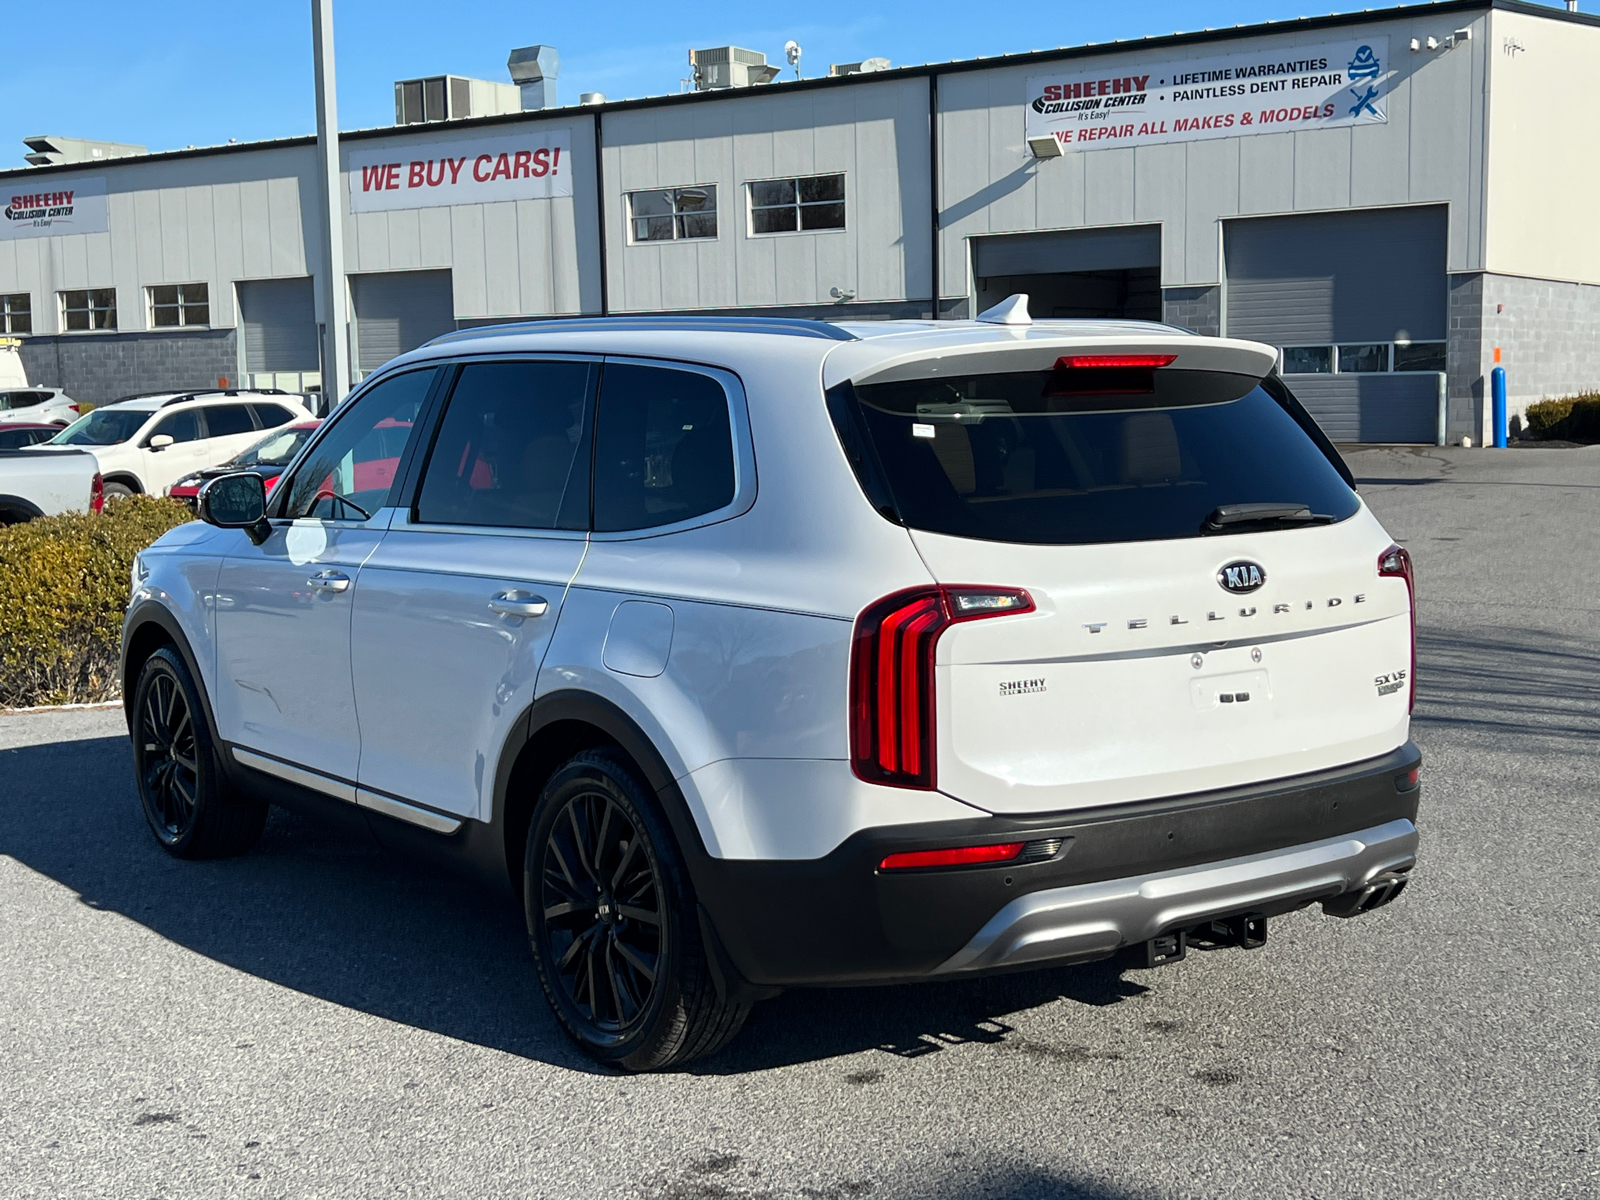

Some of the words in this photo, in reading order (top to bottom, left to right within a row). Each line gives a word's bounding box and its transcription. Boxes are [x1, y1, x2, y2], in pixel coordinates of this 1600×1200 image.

[1172, 68, 1232, 87] LIFETIME
[1235, 57, 1328, 79] WARRANTIES
[1043, 75, 1150, 102] SHEEHY
[1172, 84, 1246, 102] PAINTLESS
[1250, 79, 1288, 94] DENT
[1291, 73, 1342, 90] REPAIR
[1044, 98, 1102, 114] COLLISION
[1103, 93, 1147, 108] CENTER
[1078, 112, 1089, 121] It's
[1090, 109, 1111, 120] Easy!
[1077, 124, 1135, 142] REPAIR
[1137, 121, 1168, 137] ALL
[1173, 113, 1235, 132] MAKES
[1239, 112, 1254, 126] &
[1258, 103, 1336, 124] MODELS
[362, 163, 402, 192] WE
[407, 156, 467, 189] BUY
[472, 147, 561, 183] CARS!
[11, 190, 74, 210] SHEEHY
[13, 208, 47, 221] COLLISION
[47, 206, 74, 218] CENTER
[1225, 565, 1263, 588] KIA
[1082, 593, 1366, 634] TELLURIDE
[999, 678, 1045, 690] SHEEHY
